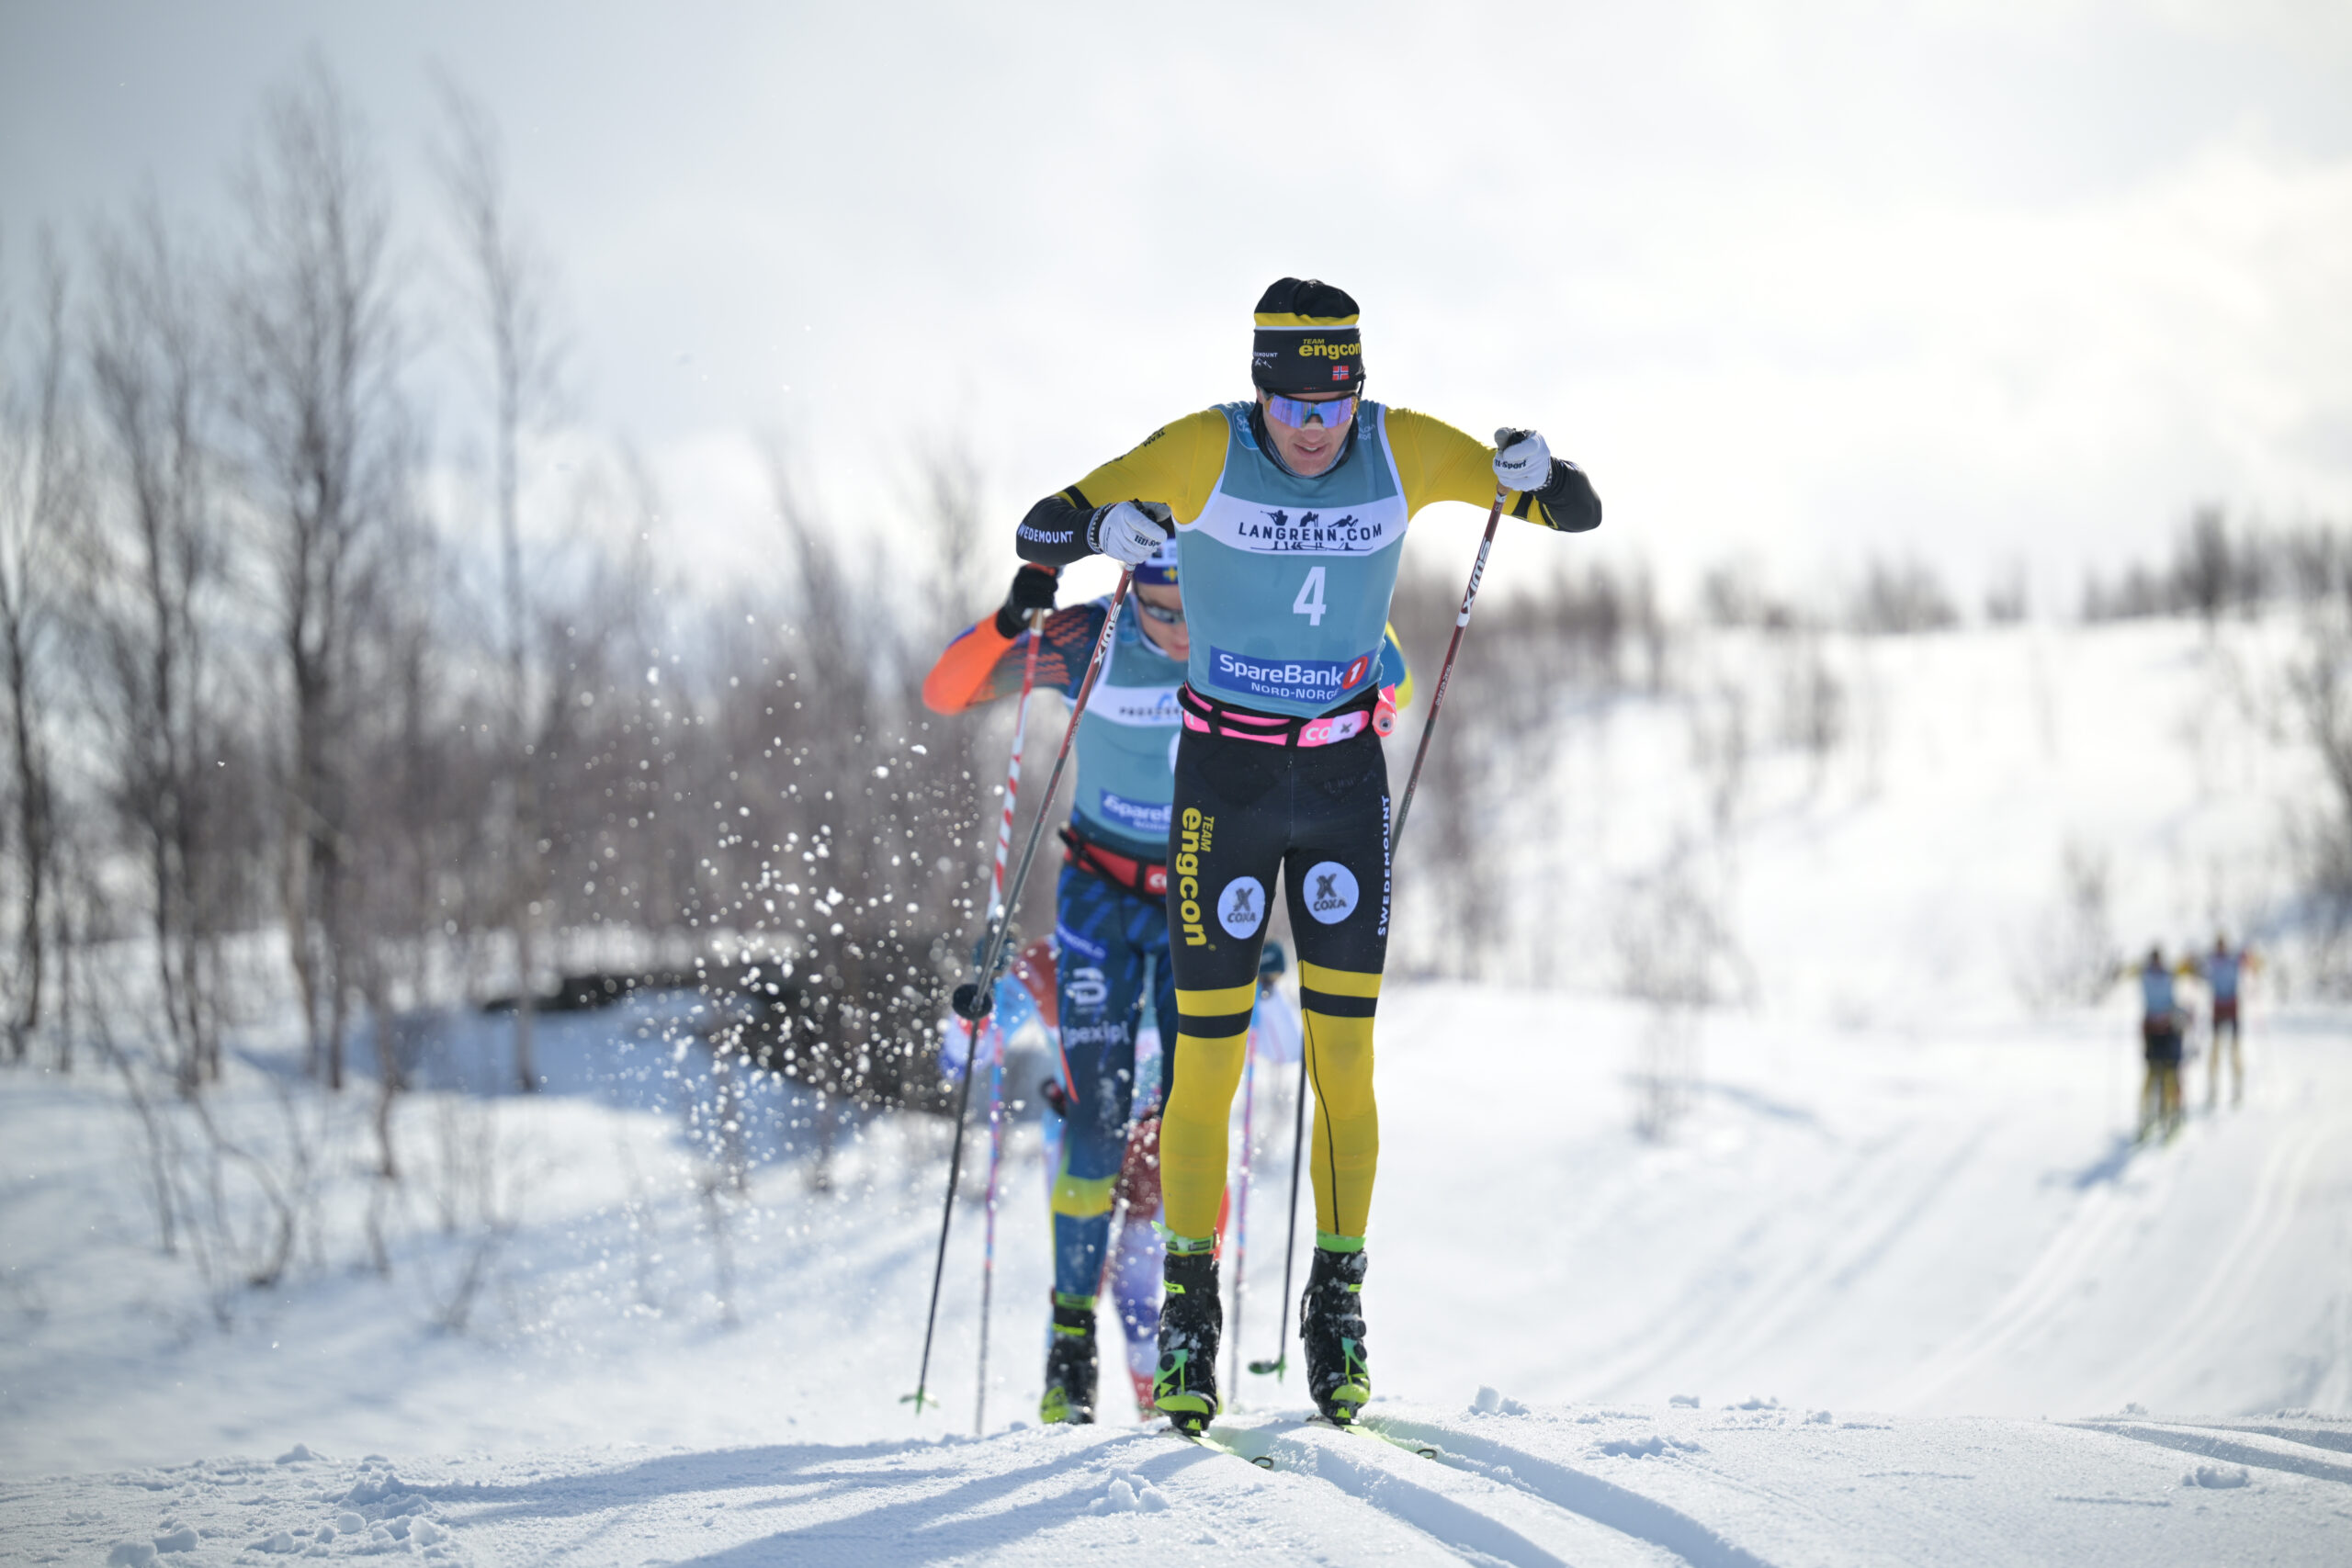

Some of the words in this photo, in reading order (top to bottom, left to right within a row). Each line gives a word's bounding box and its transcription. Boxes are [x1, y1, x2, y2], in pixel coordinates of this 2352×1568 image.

[1298, 343, 1361, 360] engcon
[1238, 521, 1383, 542] LANGRENN.COM
[1463, 536, 1490, 615] SWIX
[1293, 566, 1327, 626] 4
[1093, 602, 1122, 667] SWIX
[1219, 653, 1344, 686] SpareBank
[1349, 661, 1363, 683] 1
[1200, 816, 1215, 852] TEAM
[1175, 807, 1207, 946] engcon
[1377, 795, 1391, 937] SWEDEMOUNT
[1227, 911, 1257, 924] COXA
[1313, 898, 1348, 912] COXA
